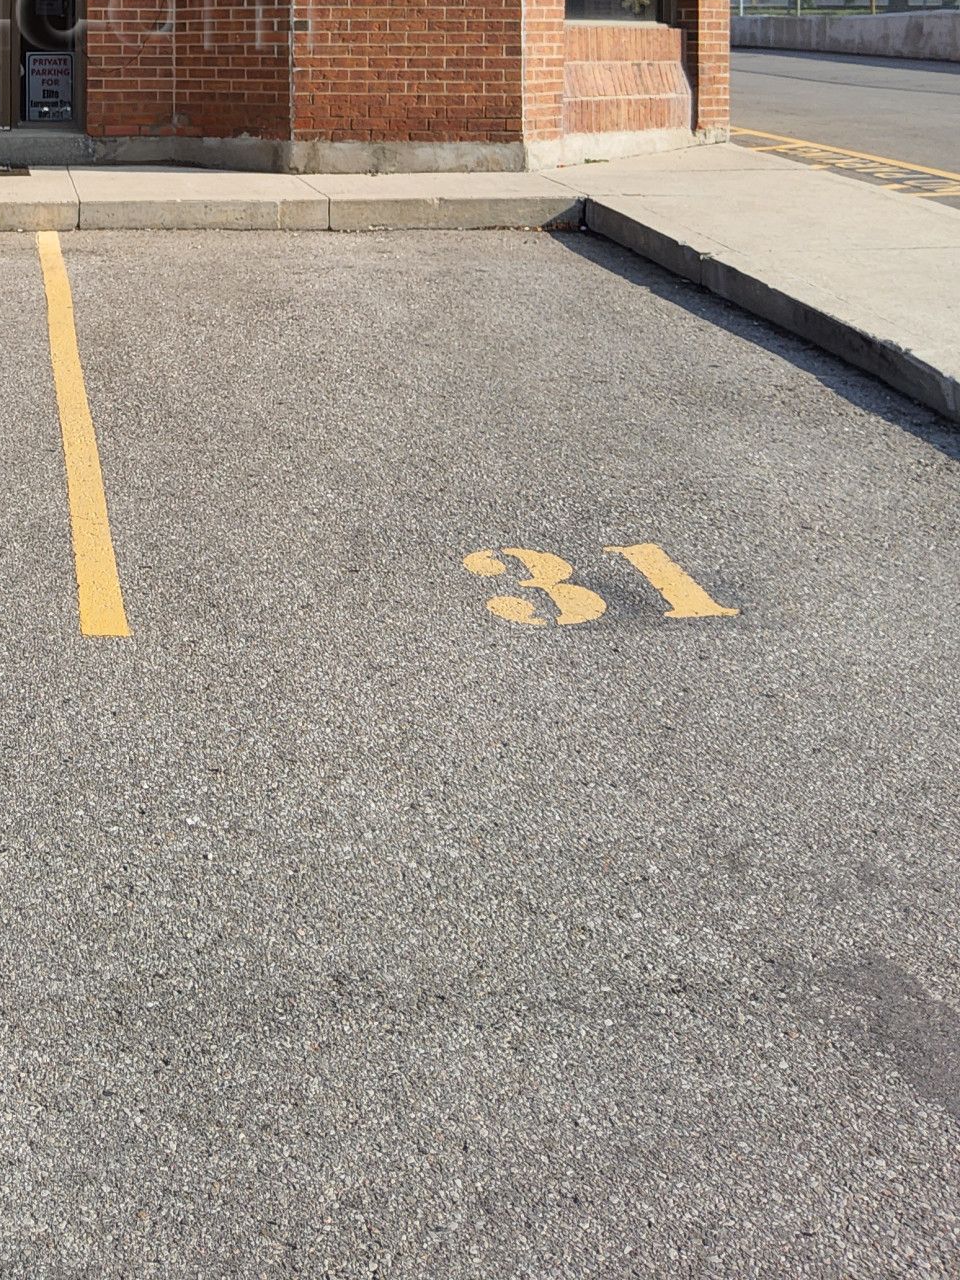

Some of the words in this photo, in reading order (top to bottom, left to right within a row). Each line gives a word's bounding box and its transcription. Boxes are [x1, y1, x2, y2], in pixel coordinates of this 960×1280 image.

[32, 58, 68, 66] PRIVATE
[31, 68, 70, 76] PARKING
[463, 543, 741, 625] 31
